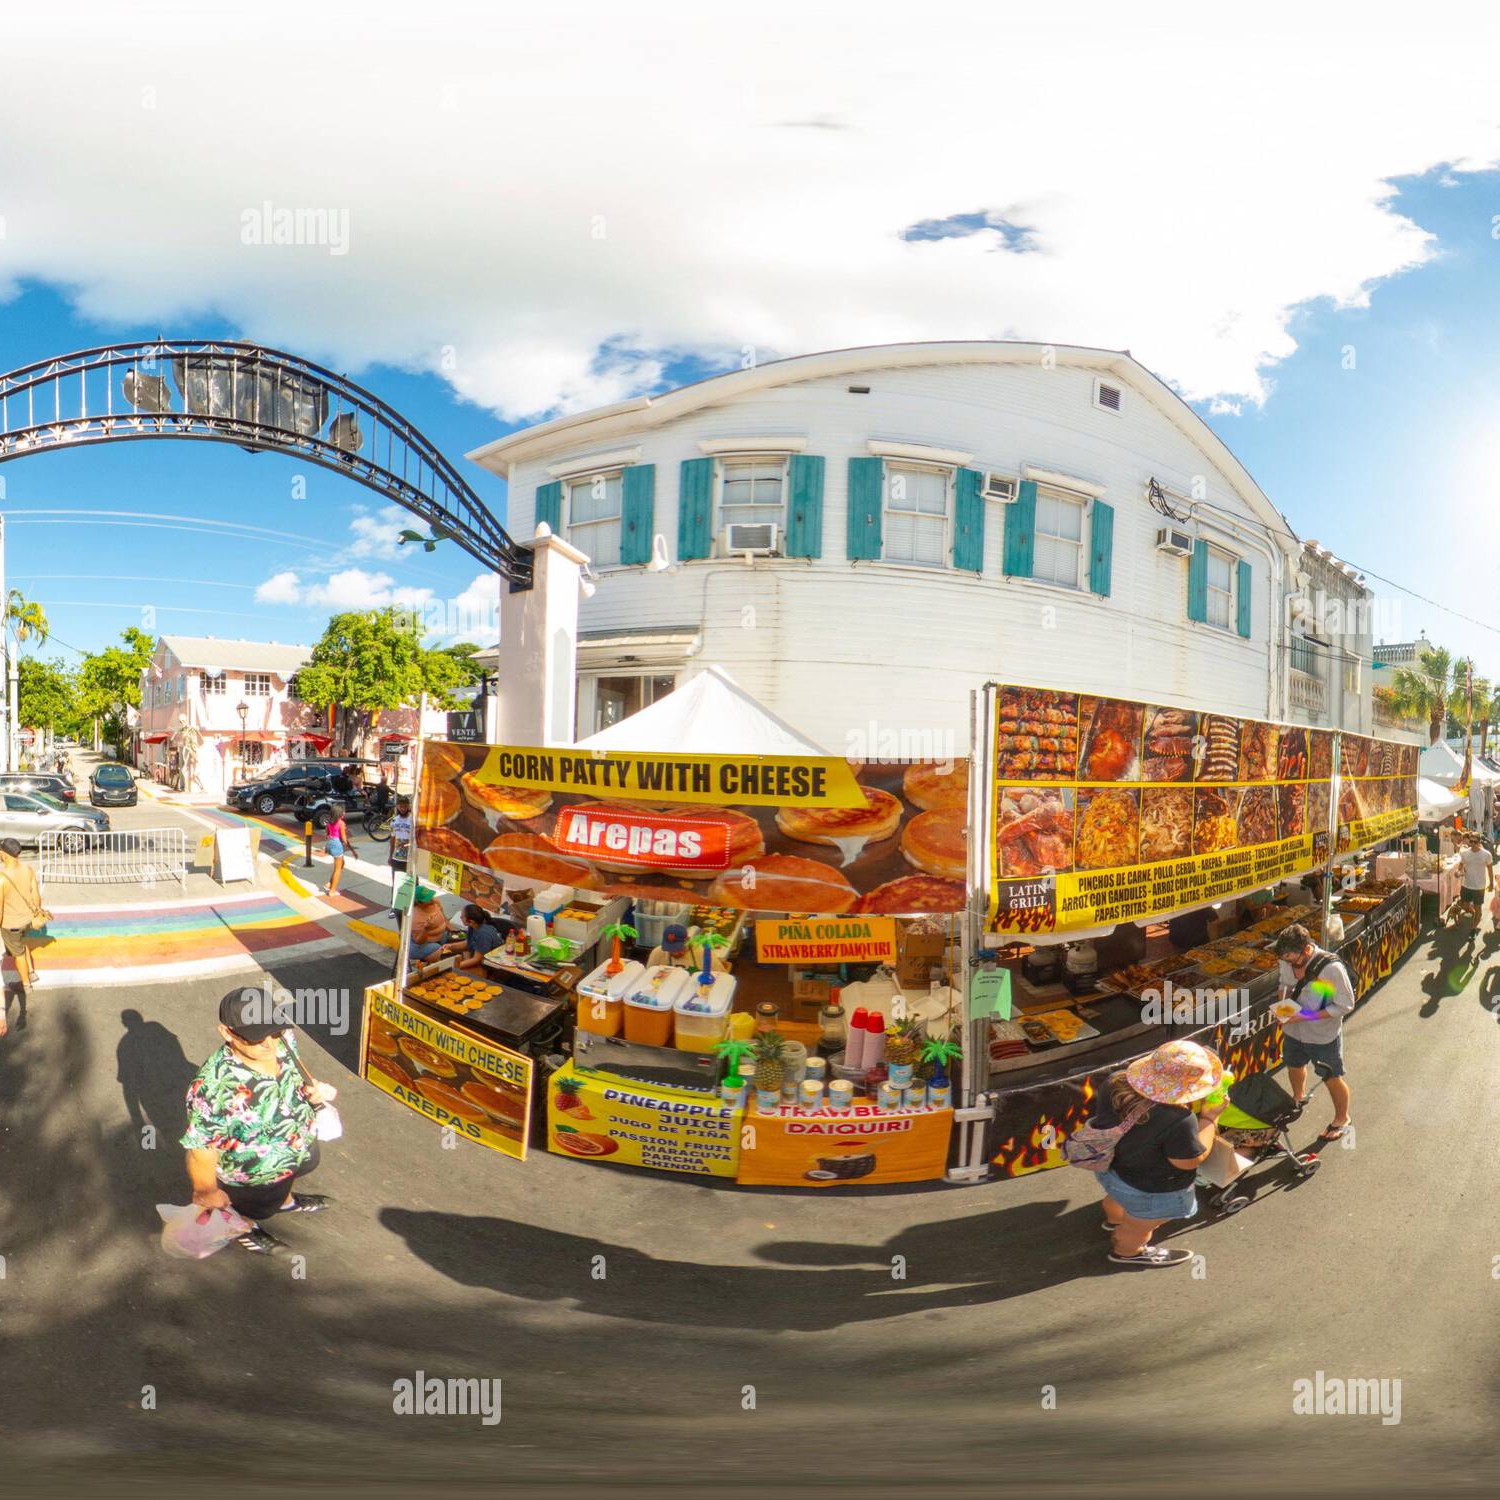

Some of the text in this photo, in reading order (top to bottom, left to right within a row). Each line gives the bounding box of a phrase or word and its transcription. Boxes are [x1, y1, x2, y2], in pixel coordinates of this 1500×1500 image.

[452, 728, 476, 736] VENTE
[500, 752, 826, 797] CORN PATTY WITH CHEESE
[566, 814, 702, 858] Arepas
[1079, 874, 1114, 892] PINCHOS
[1116, 873, 1125, 886] DE
[1176, 861, 1196, 876] CERDO
[1202, 856, 1222, 871] AREPAS
[1008, 884, 1048, 897] LATIN
[1061, 894, 1088, 911] ARROZ
[1090, 892, 1106, 907] CON
[1109, 885, 1147, 903] GANDULES
[1153, 880, 1174, 896] ARROZ
[1175, 878, 1188, 891] CON
[1189, 873, 1206, 888] POLLO
[1009, 896, 1048, 910] GRILL
[1094, 906, 1120, 922] PAPAS
[1121, 901, 1147, 918] FRITAS
[1153, 895, 1175, 911] ASADO
[1180, 889, 1200, 904] ALITAS
[1204, 881, 1233, 898] COSTILLAS
[778, 922, 871, 940] PIÑA COLADA
[762, 942, 890, 960] STRAWBERRY DAIQUIRI
[374, 996, 524, 1083] CORN PATTY WITH CHEESE
[393, 1085, 481, 1138] AREPAS
[604, 1089, 733, 1119] PINEAPPLE
[608, 1116, 730, 1140] JUGO DE PIÑA
[660, 1114, 732, 1131] JUICE
[788, 1120, 910, 1135] DAIQUIRI
[609, 1129, 733, 1153] PASSION FRUIT
[642, 1145, 731, 1161] MARACUYA
[642, 1152, 705, 1165] PARCHA
[642, 1159, 711, 1173] CHINOLA
